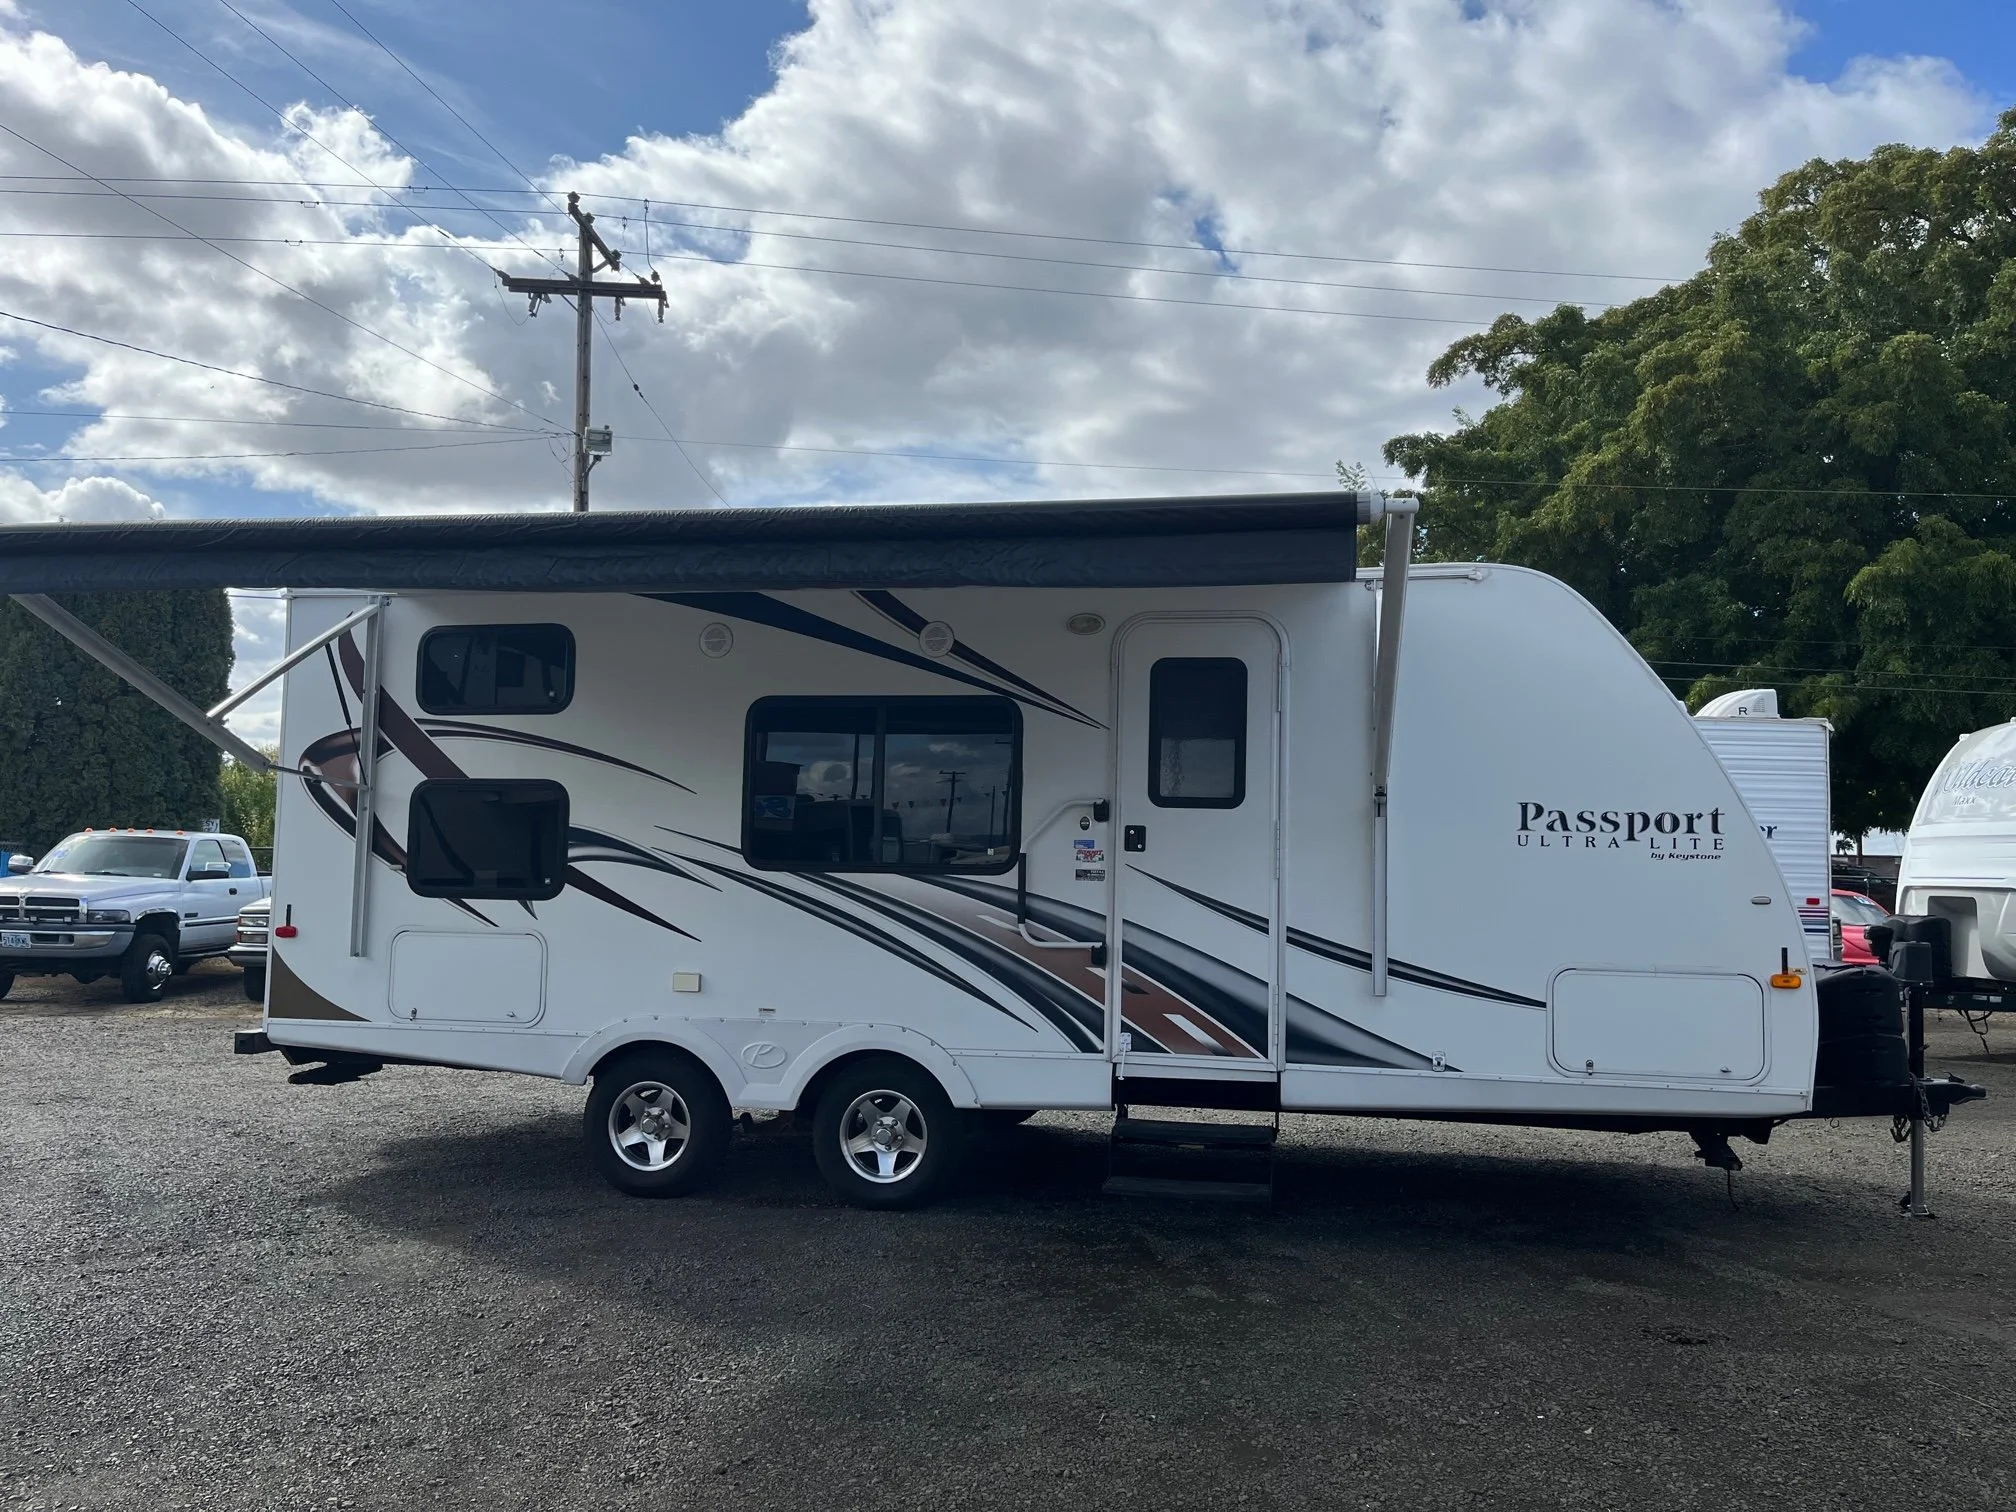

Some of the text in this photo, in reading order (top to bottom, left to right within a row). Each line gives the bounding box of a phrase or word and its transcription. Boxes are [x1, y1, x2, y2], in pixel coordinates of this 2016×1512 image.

[1516, 801, 1726, 842] Passport
[1517, 834, 1725, 851] ULTRA LITE
[1650, 852, 1722, 861] by Keystone
